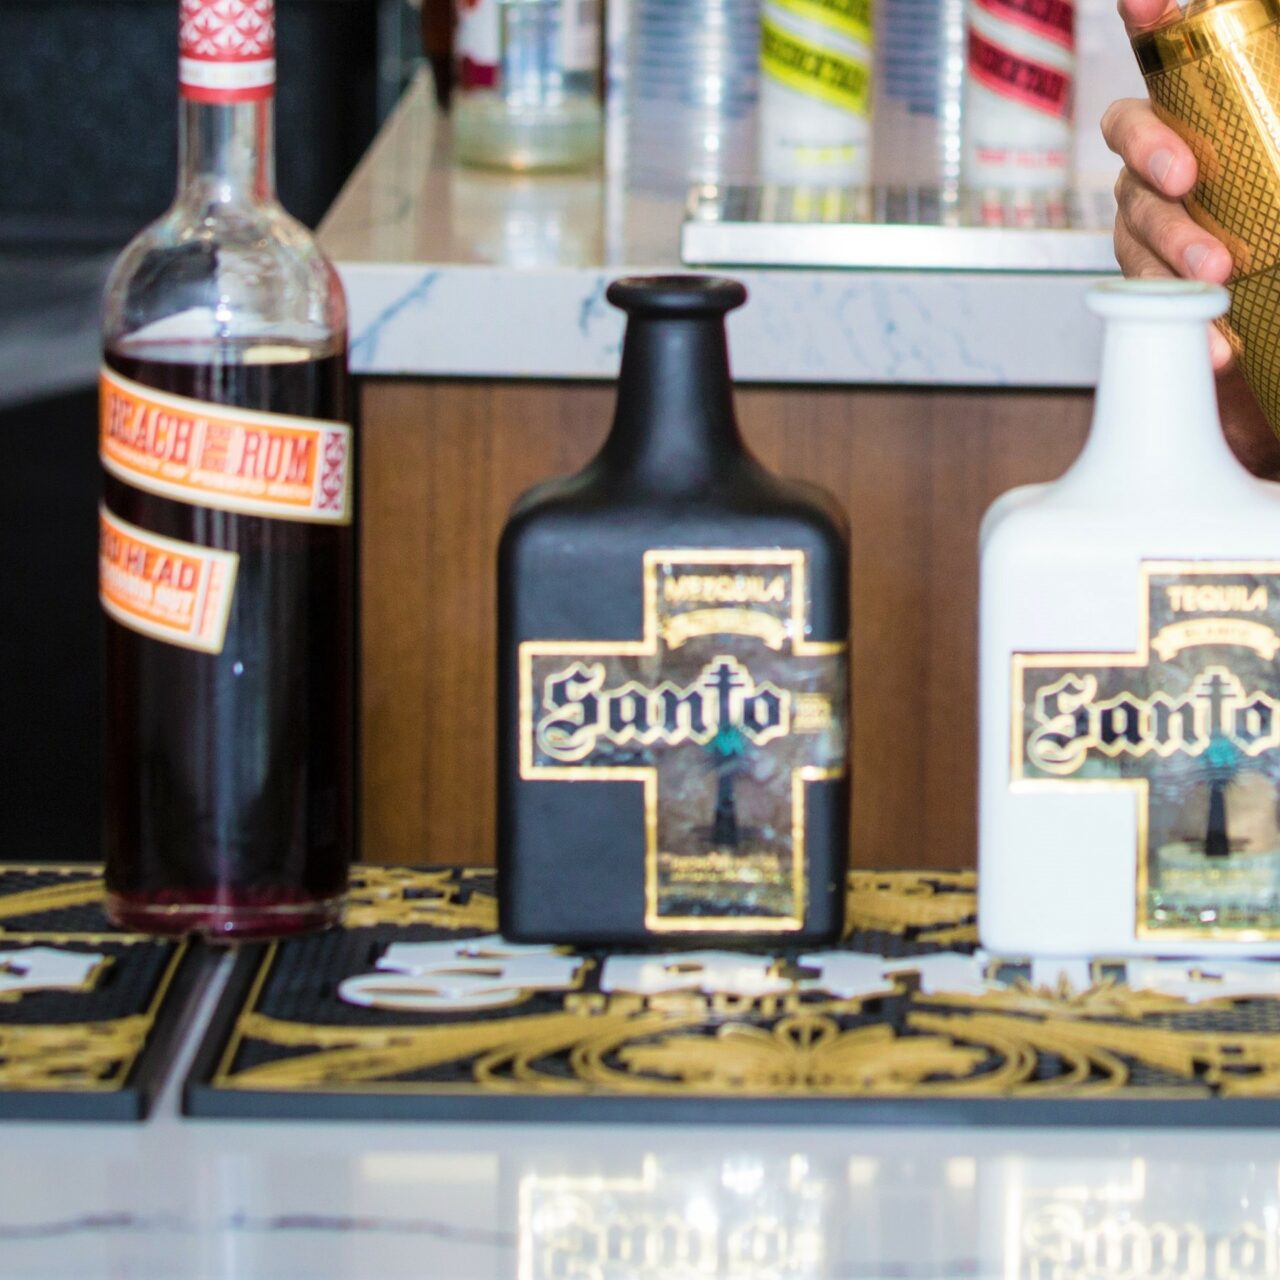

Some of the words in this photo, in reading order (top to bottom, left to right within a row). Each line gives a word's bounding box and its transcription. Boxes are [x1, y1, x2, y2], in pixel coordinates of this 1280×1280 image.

[109, 392, 194, 465] BEACH
[237, 429, 312, 485] RUM
[126, 543, 195, 591] HEAD
[1165, 584, 1268, 612] TEQUILA
[537, 655, 793, 761] Santo
